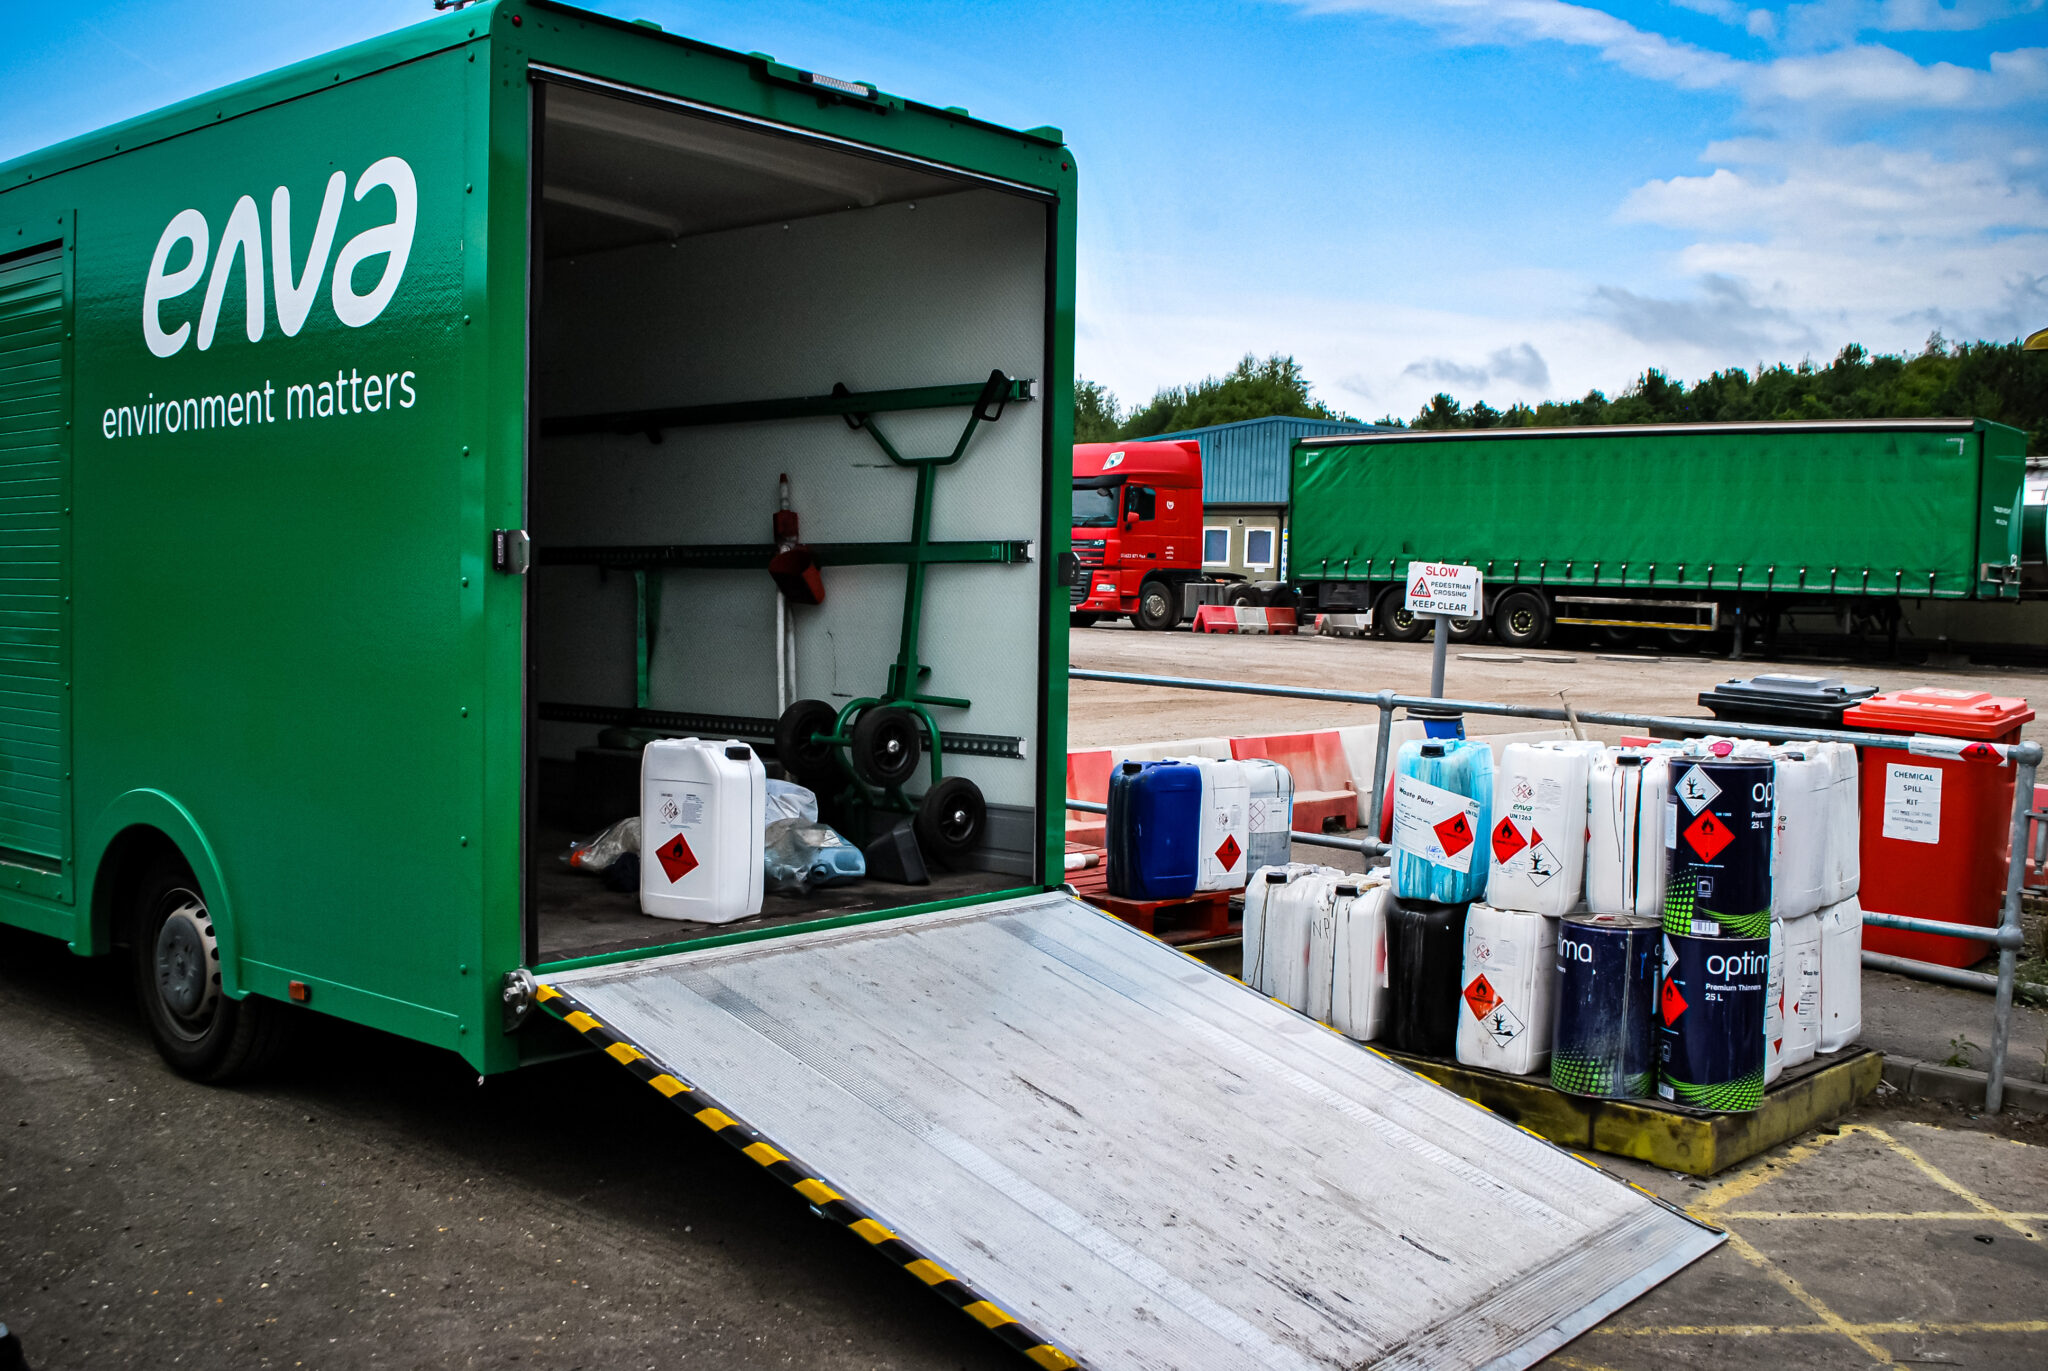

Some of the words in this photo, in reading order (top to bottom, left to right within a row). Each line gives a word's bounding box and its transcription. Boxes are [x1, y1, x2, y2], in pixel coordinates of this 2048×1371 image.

[142, 156, 418, 358] enva
[102, 379, 275, 439] environment
[286, 368, 416, 420] matters
[1425, 565, 1459, 578] SLOW
[1430, 581, 1472, 591] PEDESTRIAN
[1433, 589, 1467, 598] CROSSING
[1412, 599, 1436, 609] KEEP
[1437, 601, 1467, 612] CLEAR
[1893, 770, 1934, 782] CHEMICAL
[1903, 784, 1922, 793] SPILL
[1399, 787, 1416, 799] Waste
[1416, 795, 1434, 806] Paint
[1906, 798, 1919, 806] KIT
[1512, 803, 1533, 812] enva
[1751, 821, 1760, 829] 25
[1705, 983, 1737, 991] Premium
[1705, 993, 1716, 1001] 25
[1717, 993, 1724, 1002] L
